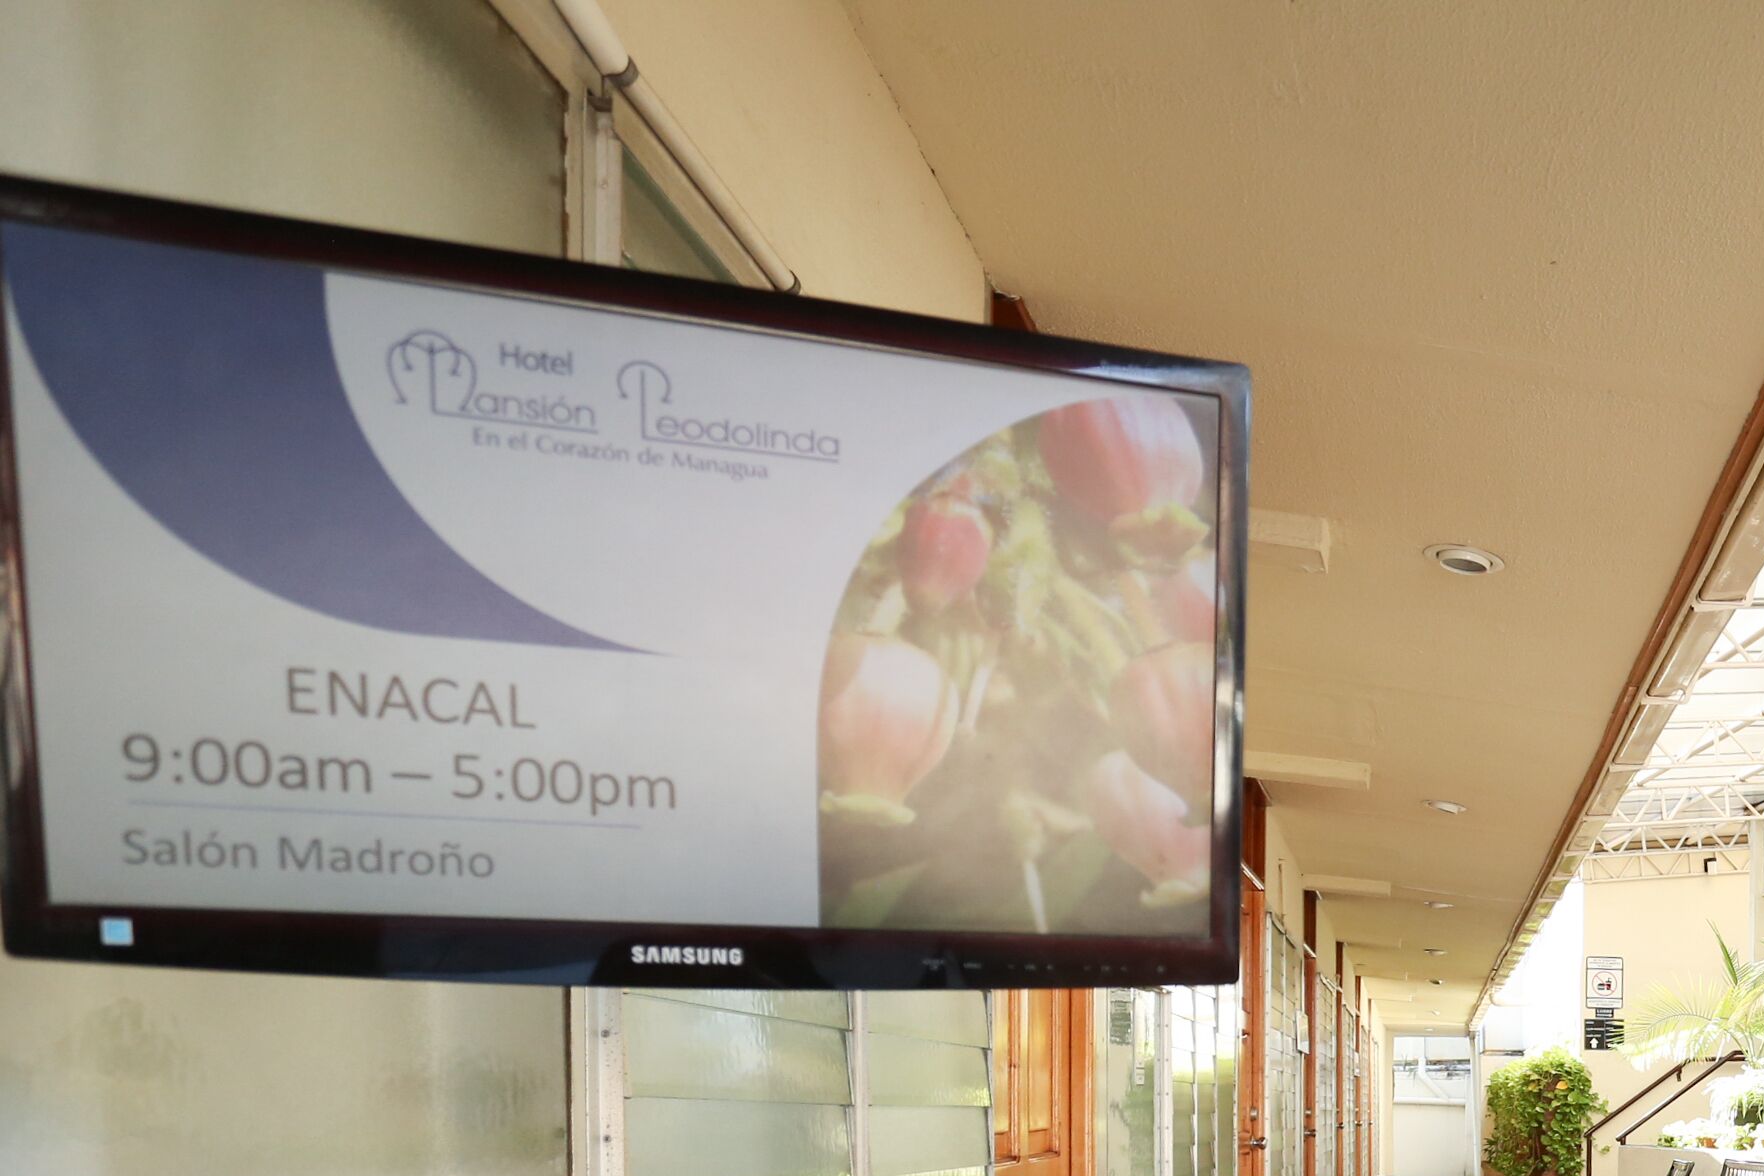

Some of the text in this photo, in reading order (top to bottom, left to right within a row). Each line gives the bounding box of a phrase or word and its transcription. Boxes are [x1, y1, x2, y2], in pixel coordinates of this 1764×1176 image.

[499, 341, 574, 377] Hotel
[385, 328, 840, 462] Mansión Teodolinda
[472, 427, 769, 481] En el Corazón de Managua
[286, 666, 537, 729] ENACAL
[121, 732, 373, 793] 9:00am
[451, 753, 677, 816] 5:00pm
[121, 828, 496, 879] Salón Madroño
[631, 945, 744, 966] SAMSUNG
